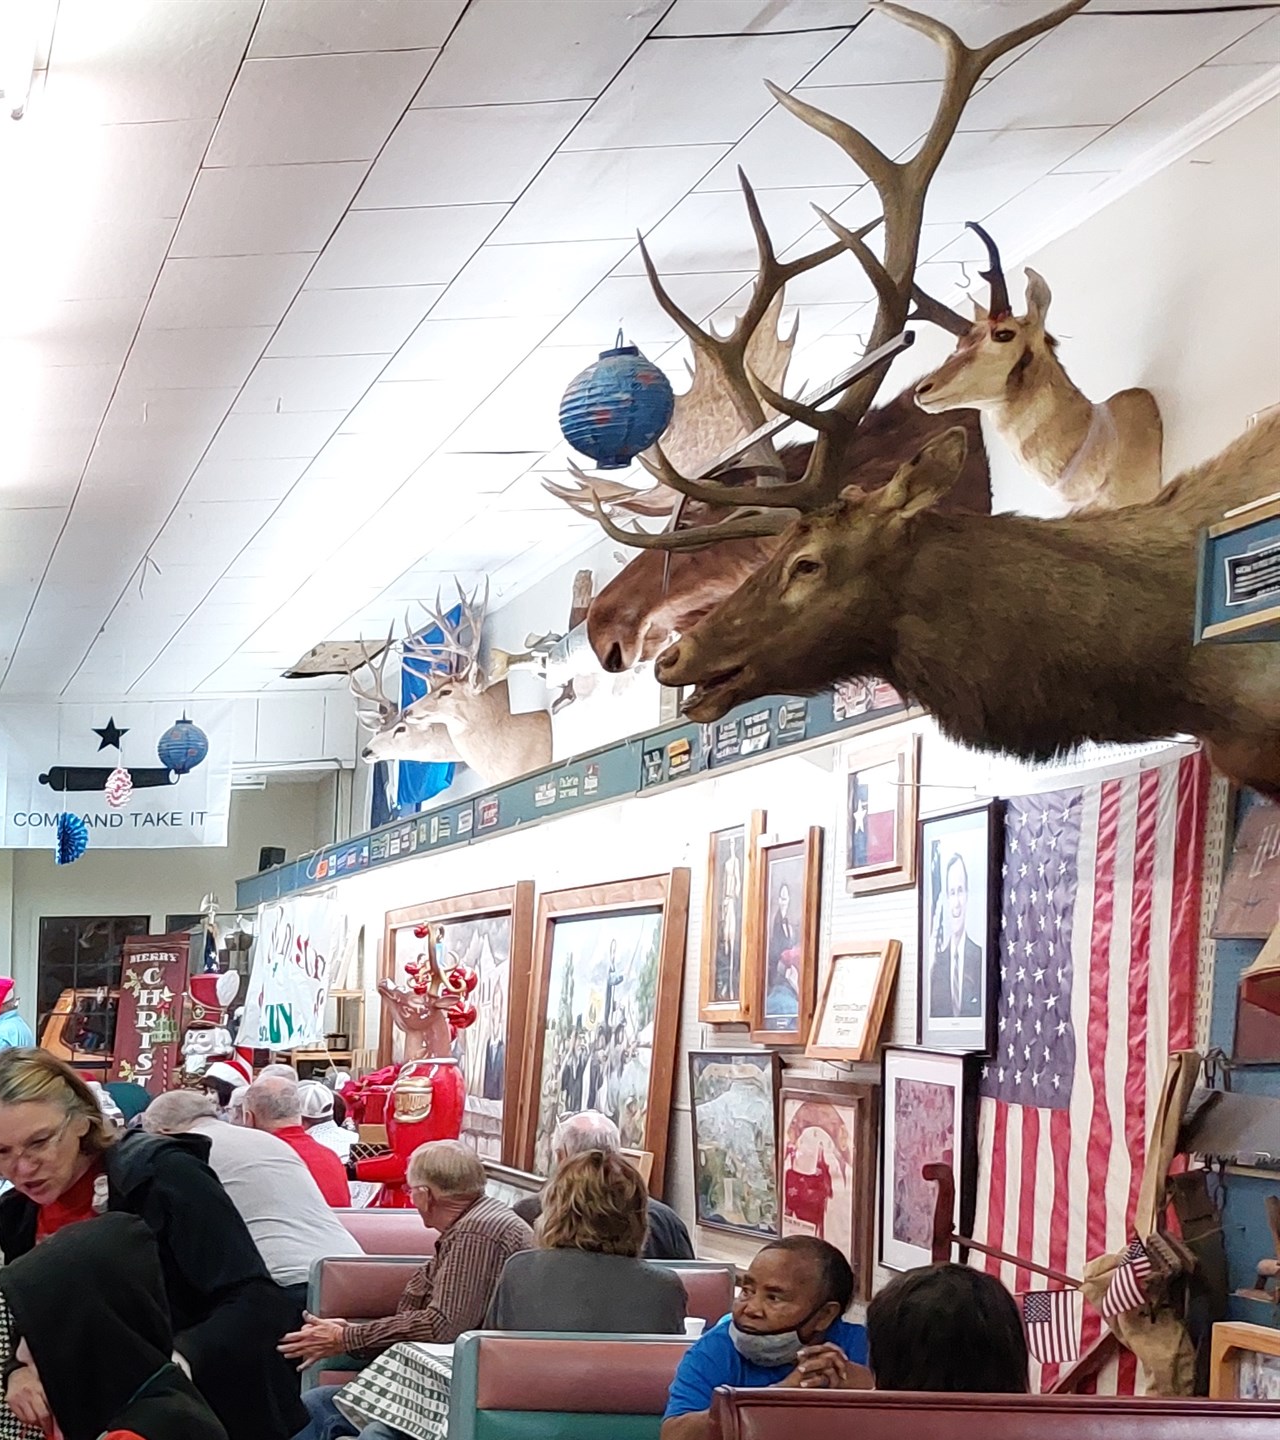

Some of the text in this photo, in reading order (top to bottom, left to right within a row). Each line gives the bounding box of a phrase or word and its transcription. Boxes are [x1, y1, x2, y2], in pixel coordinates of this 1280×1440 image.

[13, 812, 60, 827] COM
[130, 812, 183, 828] TAKE
[190, 811, 208, 826] IT
[130, 952, 180, 964] MERRY
